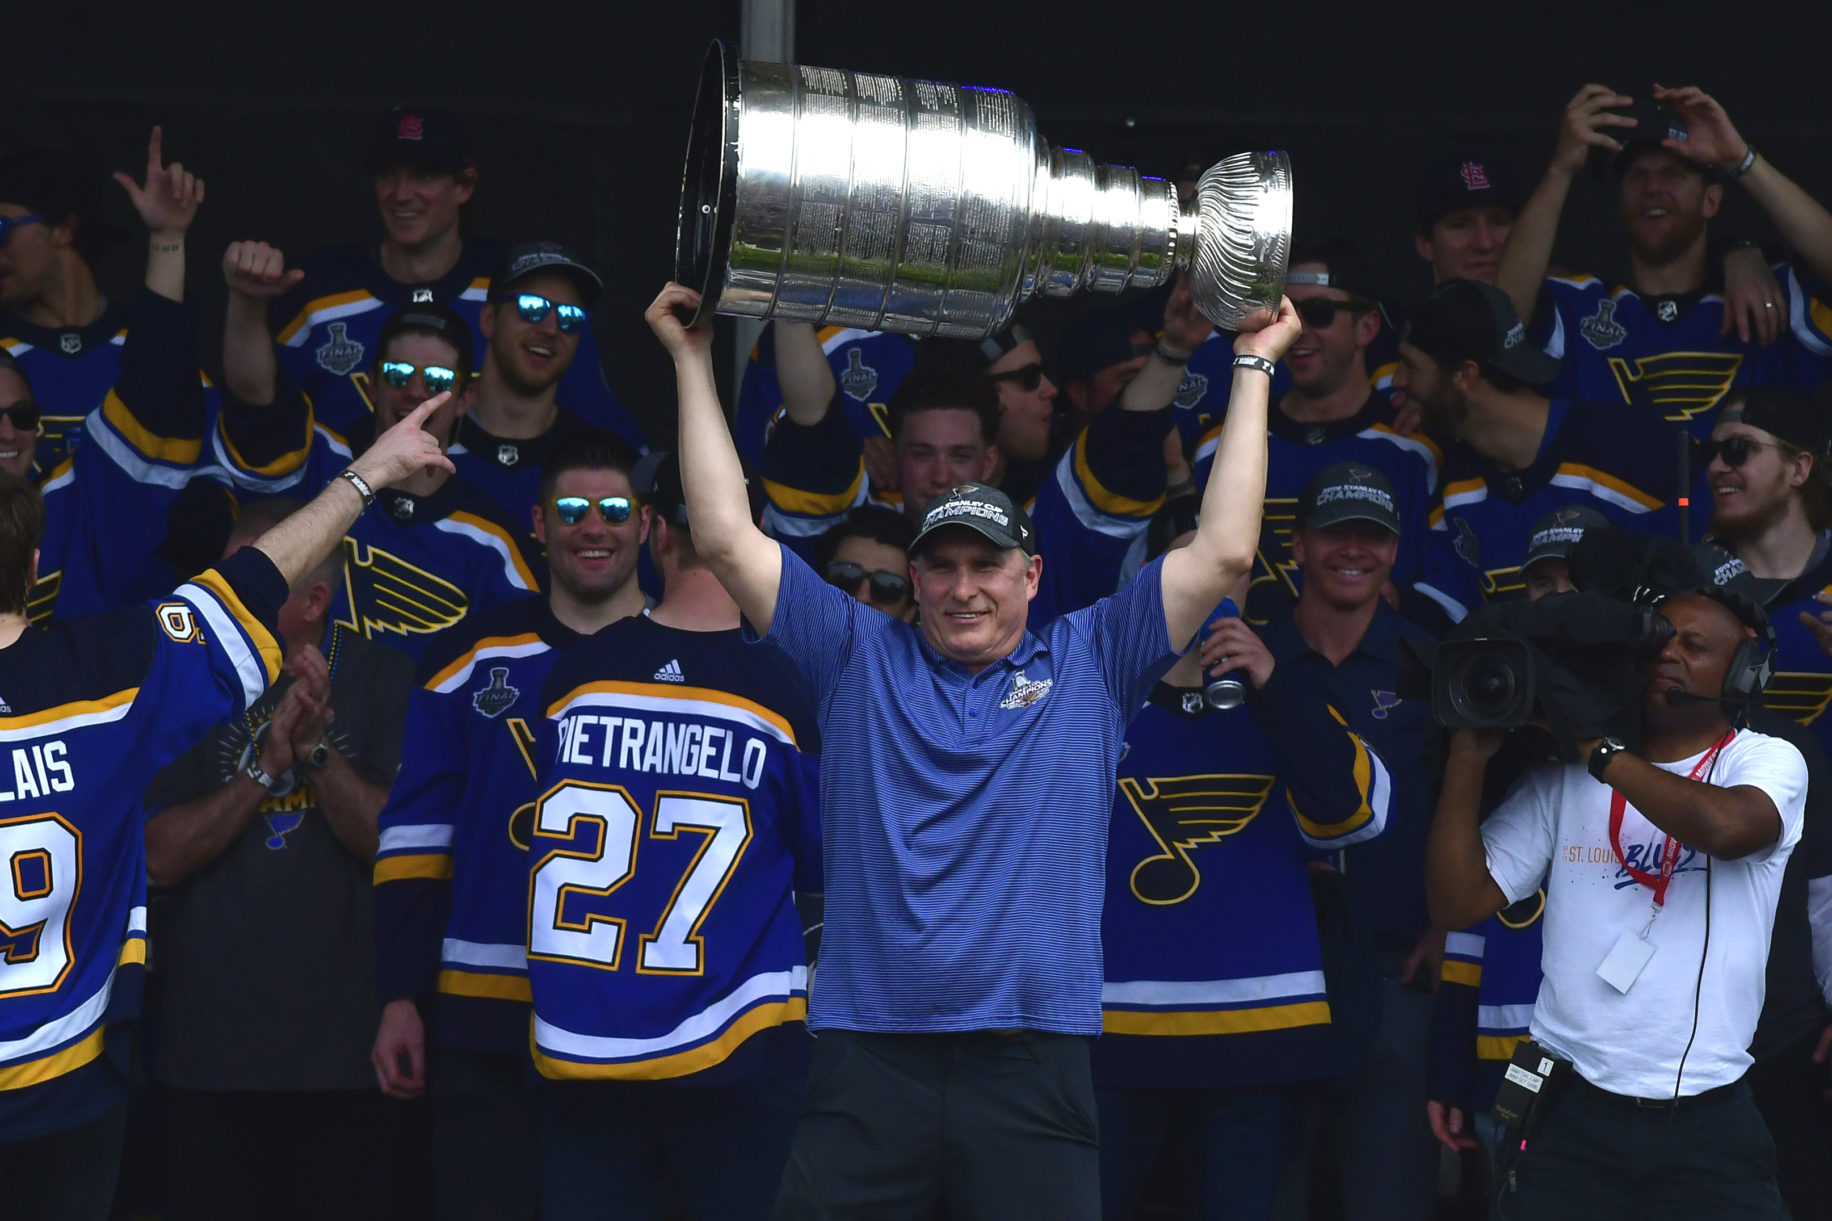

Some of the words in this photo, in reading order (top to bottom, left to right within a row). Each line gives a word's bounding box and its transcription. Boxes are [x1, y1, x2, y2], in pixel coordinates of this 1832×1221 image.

[654, 673, 685, 682] adidas
[555, 714, 767, 790] PIETRANGELO
[0, 811, 83, 999] 9
[526, 778, 754, 976] 27
